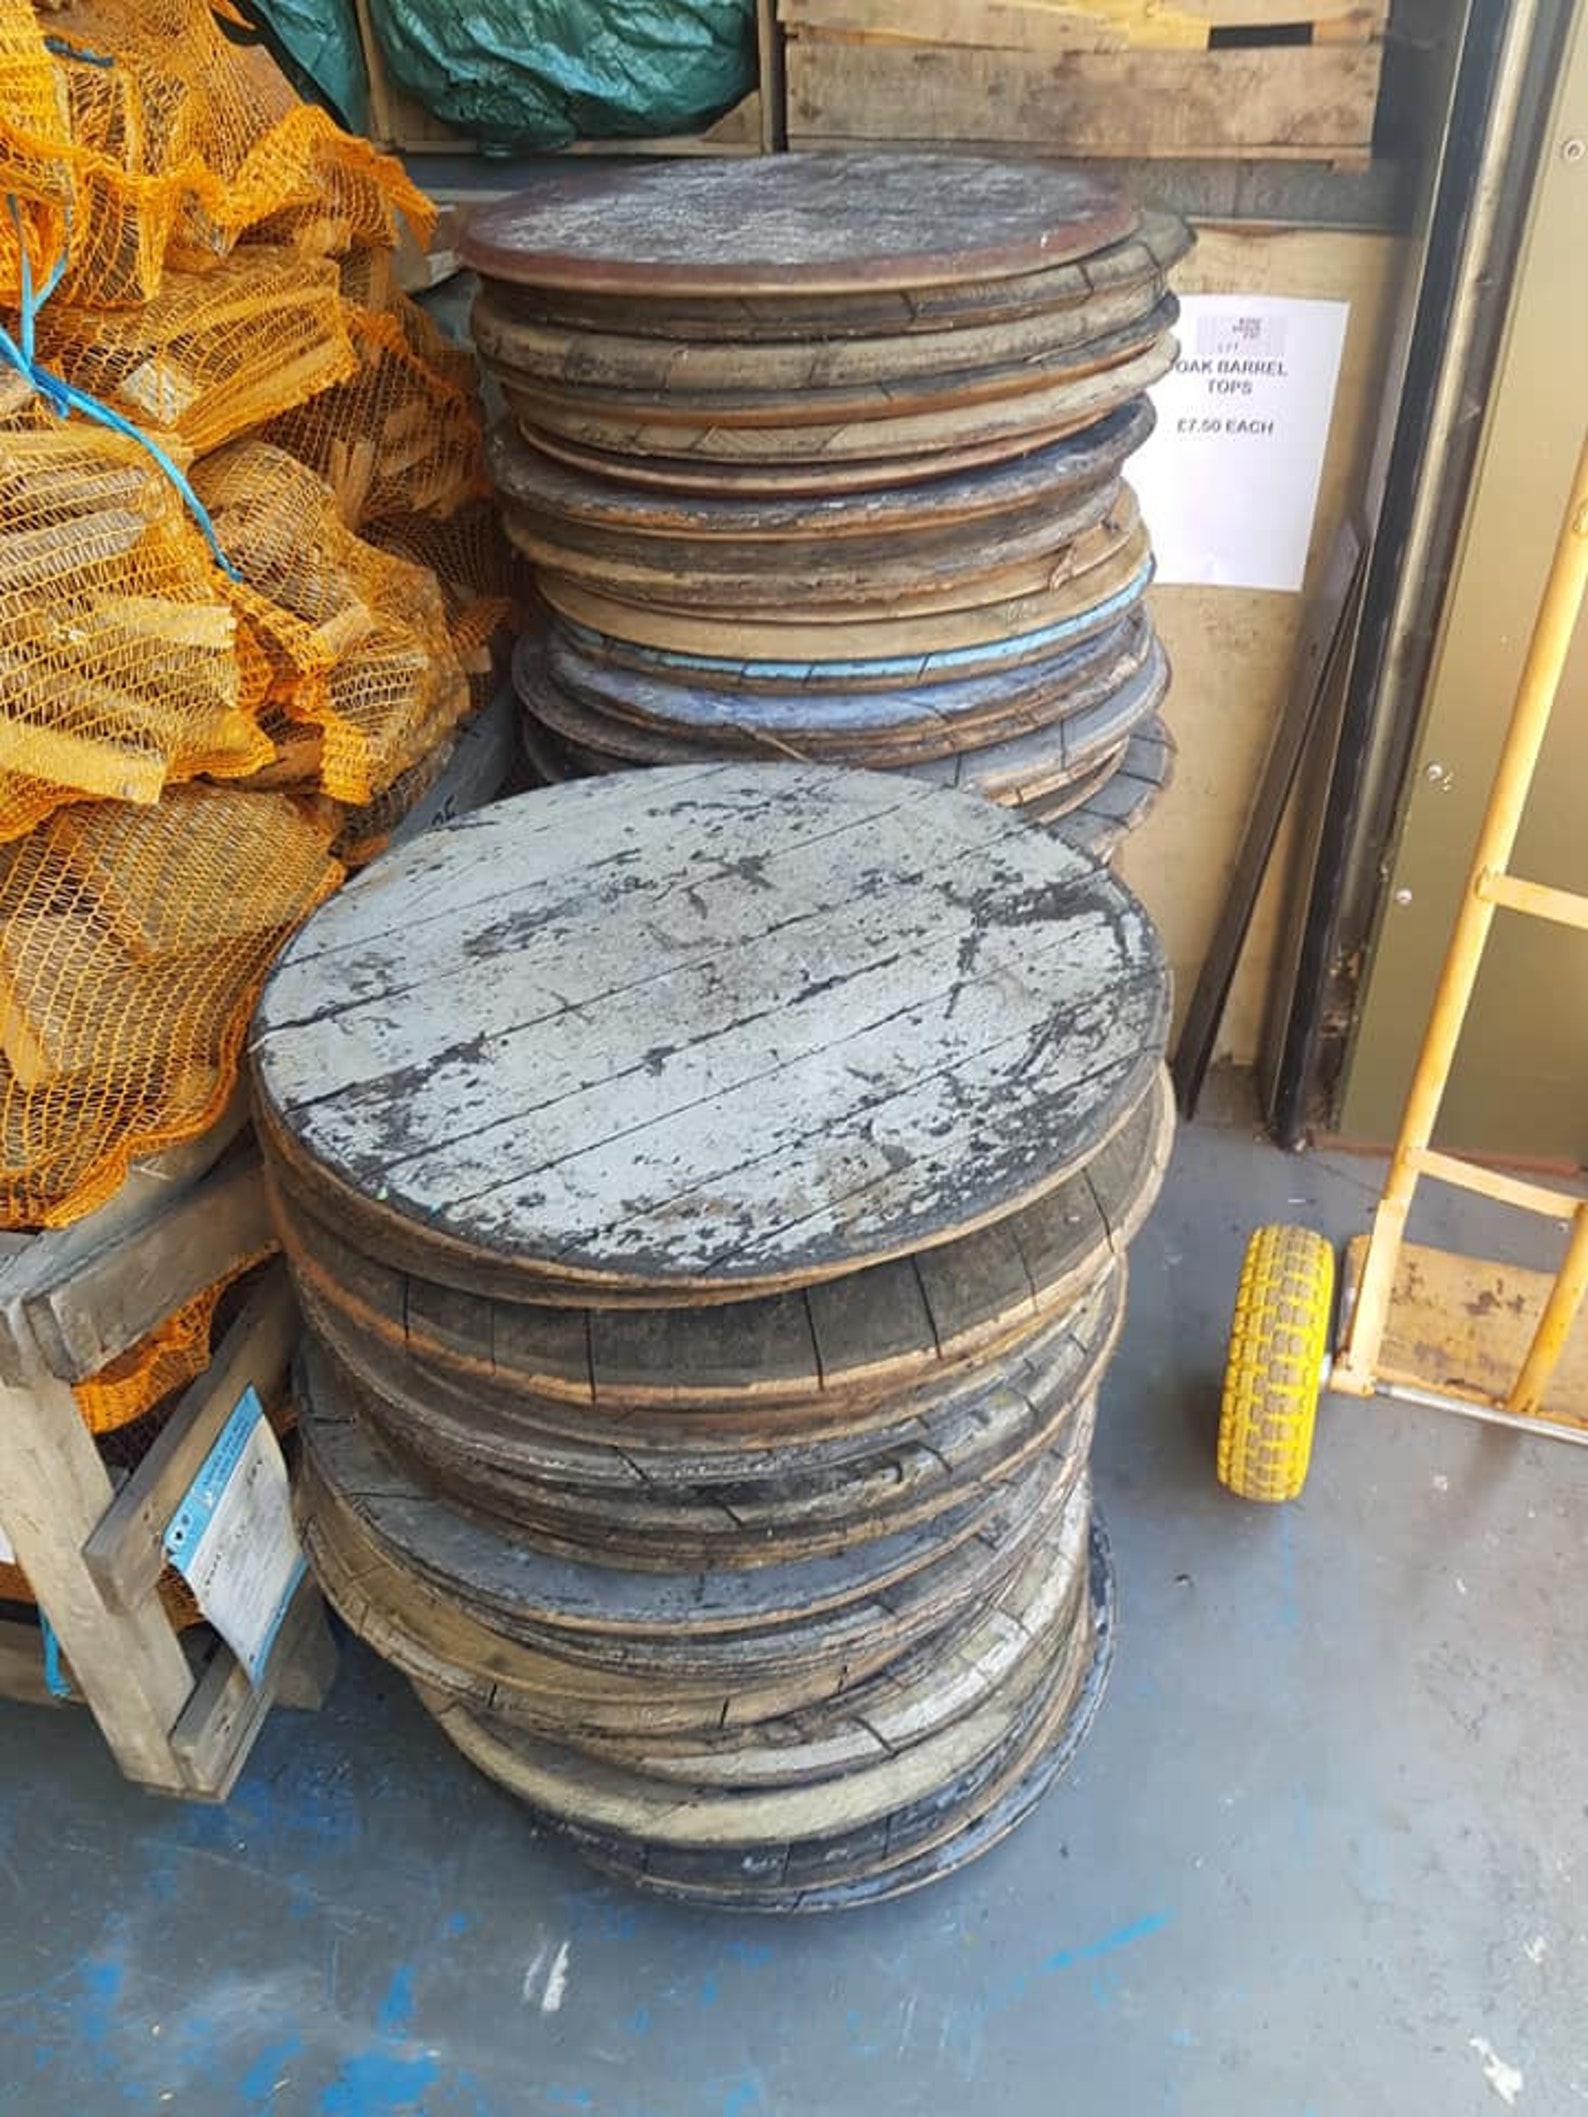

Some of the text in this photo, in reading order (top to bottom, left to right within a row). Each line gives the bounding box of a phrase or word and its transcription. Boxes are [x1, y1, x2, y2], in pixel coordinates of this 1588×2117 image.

[1175, 359, 1288, 377] OAK BARREL
[1208, 379, 1253, 395] TOPS
[1225, 419, 1274, 436] EACH
